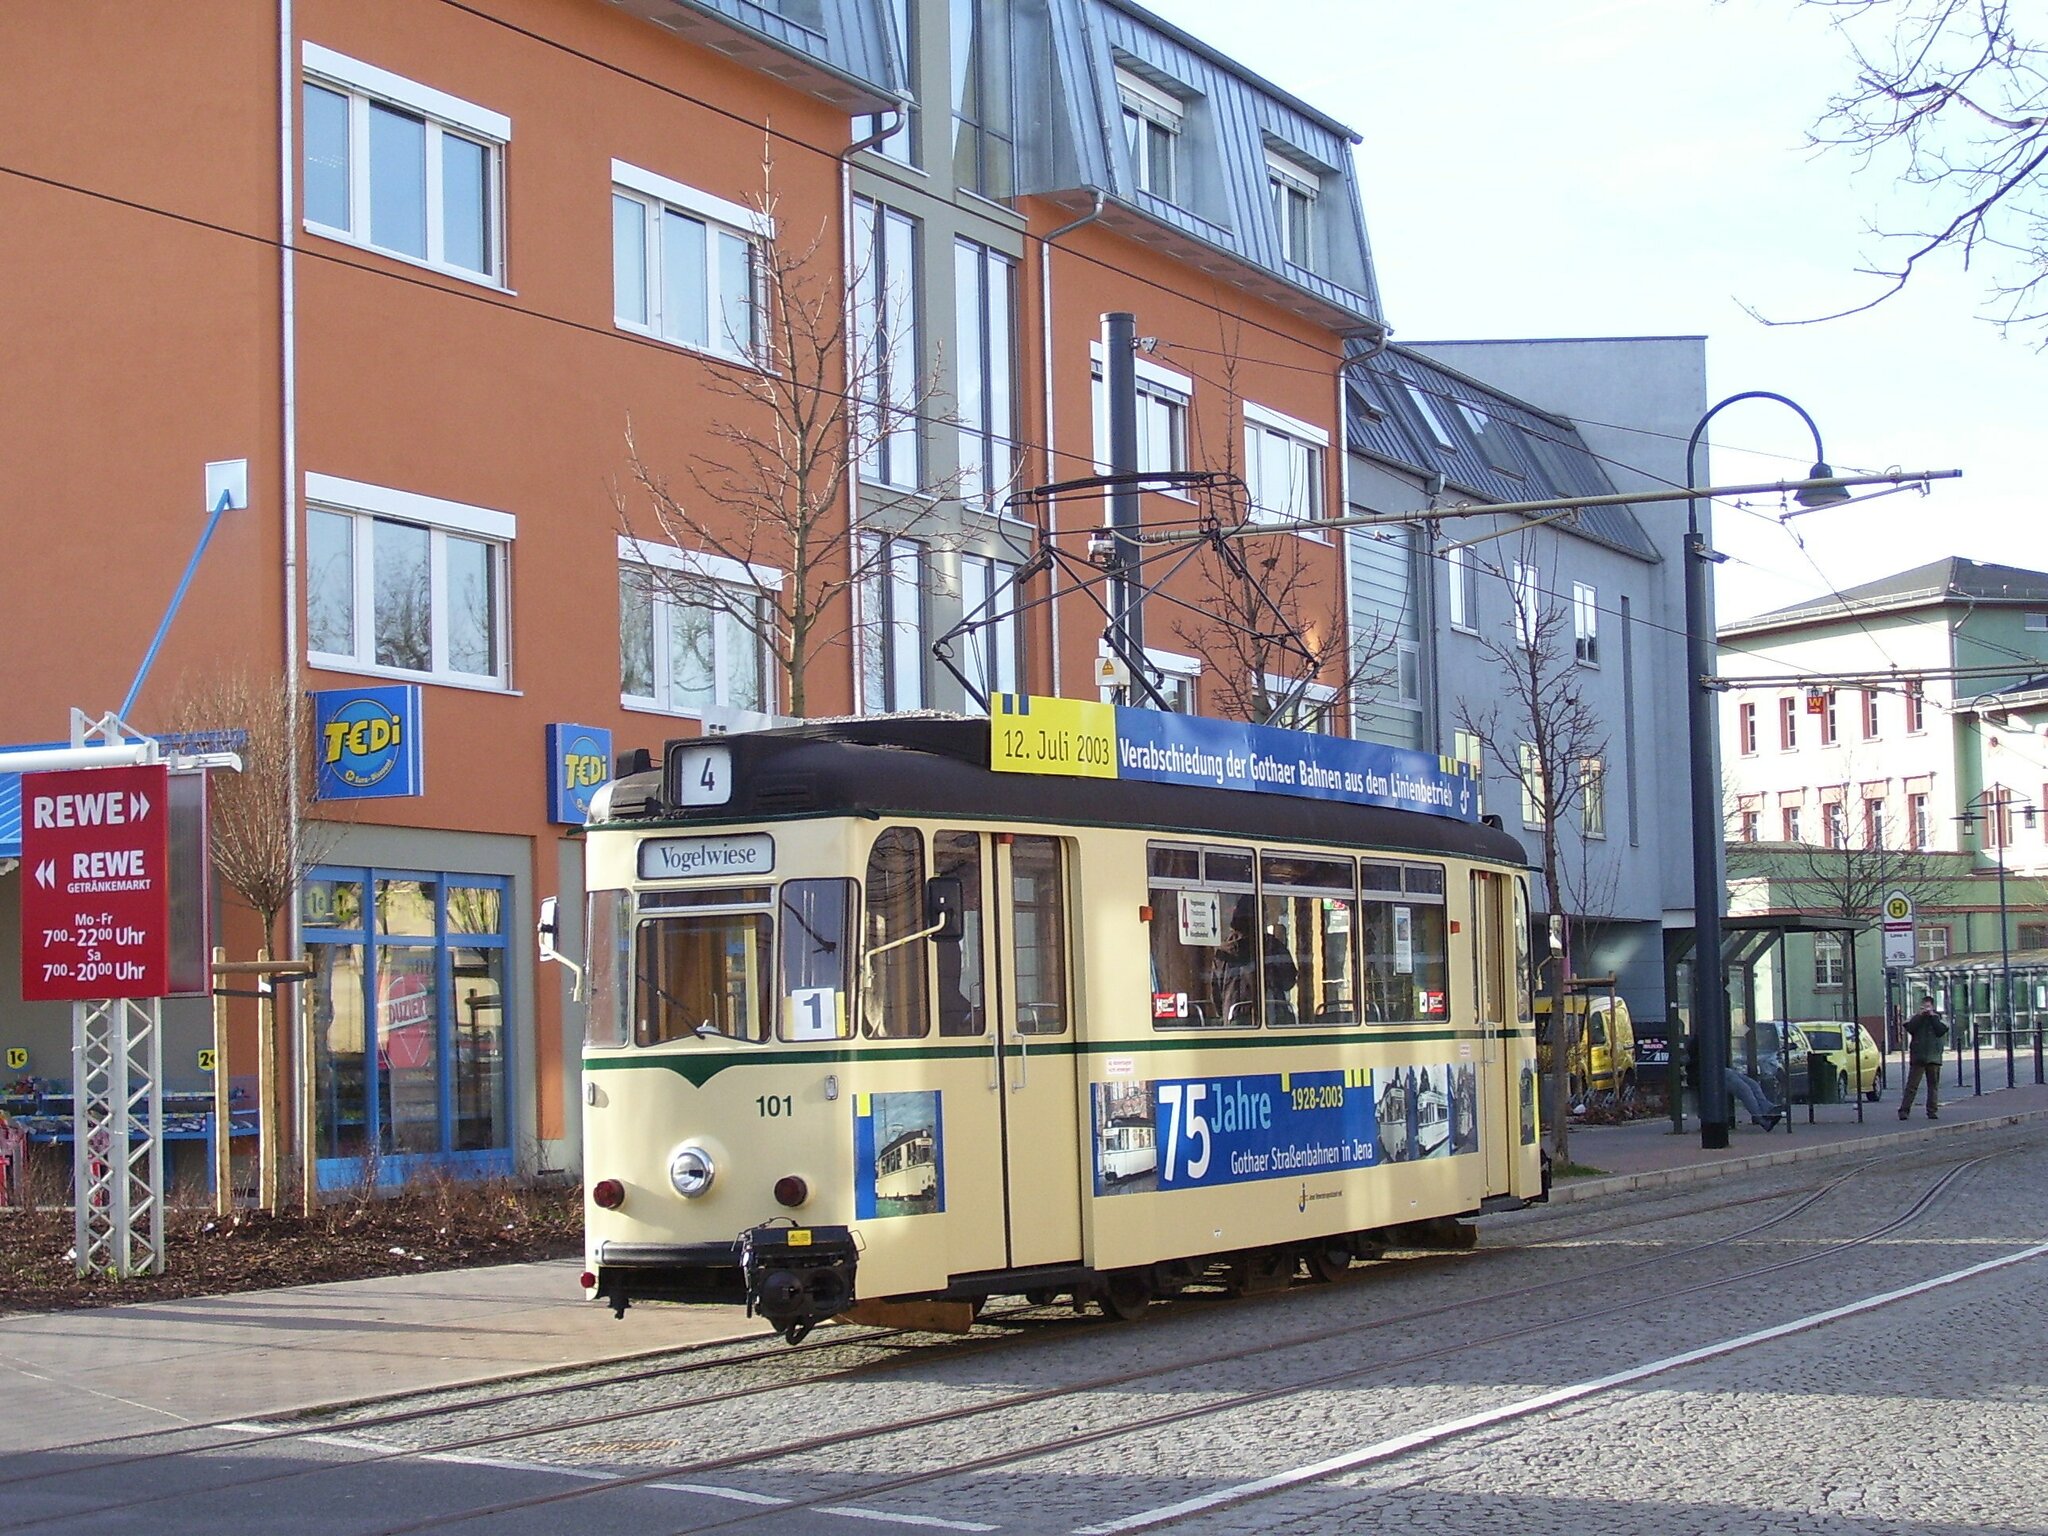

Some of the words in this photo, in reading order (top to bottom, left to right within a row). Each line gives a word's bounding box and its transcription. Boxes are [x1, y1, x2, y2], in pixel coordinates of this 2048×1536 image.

[1808, 697, 1822, 707] W
[700, 757, 715, 791] 4
[1003, 729, 1031, 759] 12.
[1036, 730, 1069, 762] Juli
[1077, 734, 1110, 766] 2003
[1119, 737, 1224, 785] Verabschiedung
[1226, 750, 1247, 780] der
[1250, 753, 1296, 785] Gothaer
[1299, 760, 1343, 791] Bahnen
[1344, 773, 1364, 795] aus
[1366, 768, 1388, 796] dem
[1391, 773, 1454, 808] Linienbetrieb
[33, 791, 125, 829] REWE
[72, 850, 145, 879] REWE
[660, 843, 757, 872] Vogelwiese
[66, 878, 152, 894] GETRÄNKEMARKT
[1892, 903, 1903, 914] H
[115, 926, 146, 946] Uhr
[86, 949, 101, 961] Sa
[115, 961, 146, 980] Uhr
[803, 993, 822, 1029] 1
[756, 1095, 792, 1117] 101
[1291, 1085, 1344, 1111] 1928-2003
[1158, 1084, 1211, 1182] 75
[1210, 1079, 1272, 1135] Jahre
[1231, 1150, 1270, 1175] Gothaer
[1271, 1143, 1340, 1170] Straßenbahnen
[1342, 1140, 1351, 1162] in
[1352, 1138, 1373, 1162] Jena
